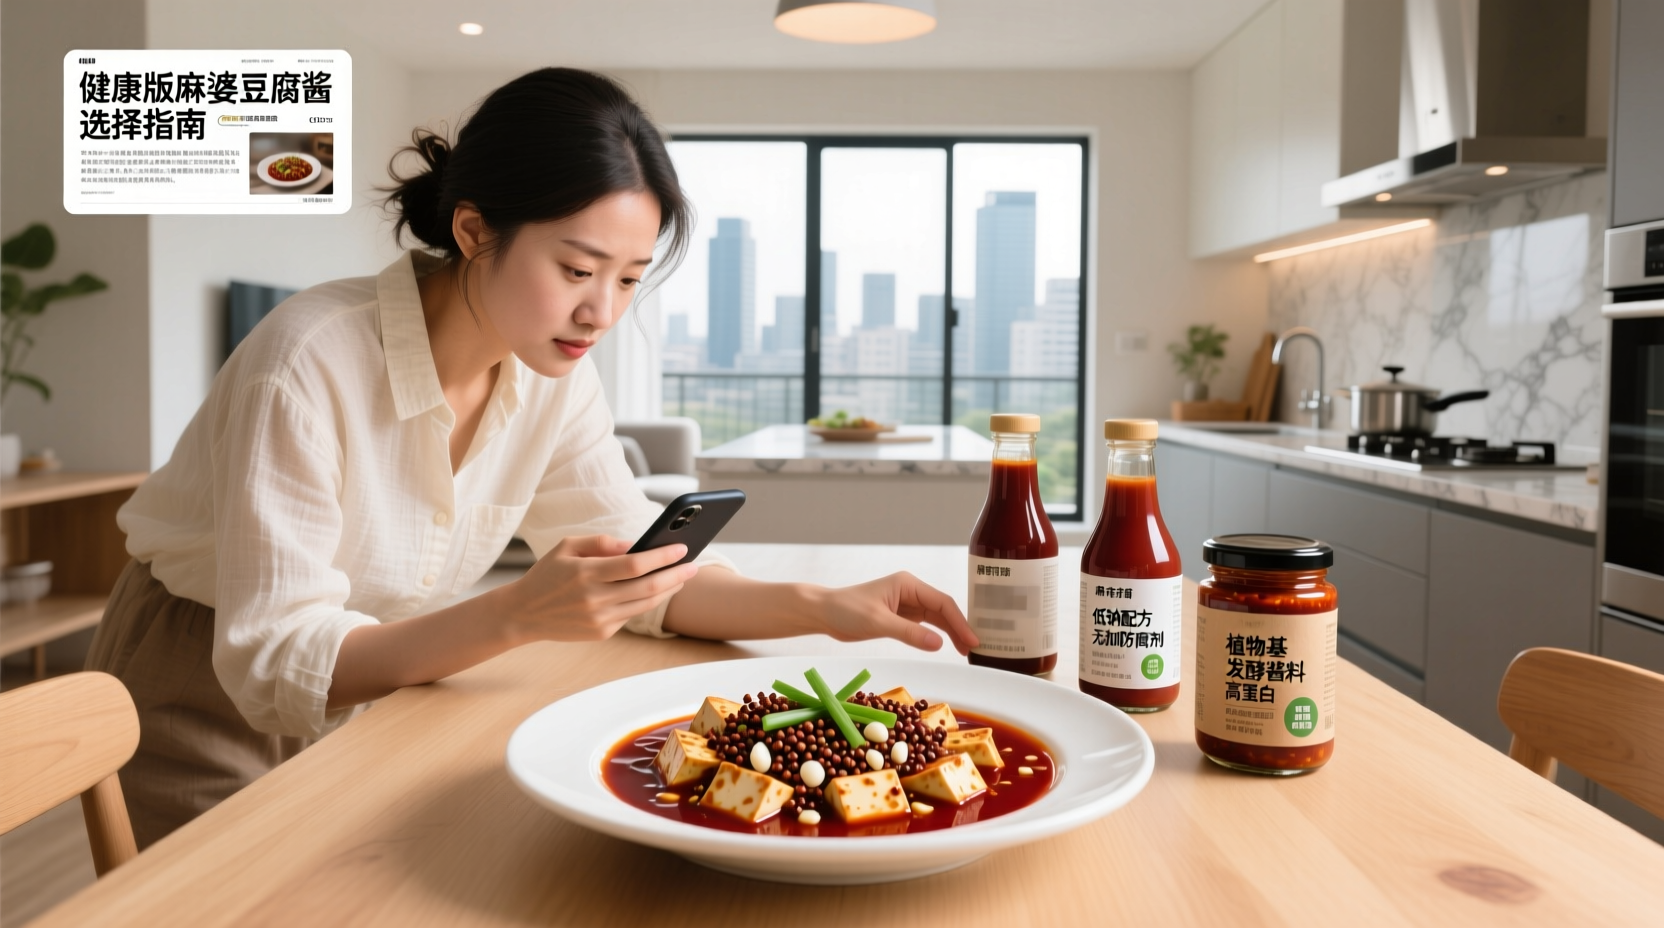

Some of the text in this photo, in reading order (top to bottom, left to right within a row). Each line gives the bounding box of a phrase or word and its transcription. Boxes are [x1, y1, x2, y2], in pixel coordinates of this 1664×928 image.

[1225, 632, 1288, 658] 植物基
[1226, 658, 1306, 683] 发酵酱料
